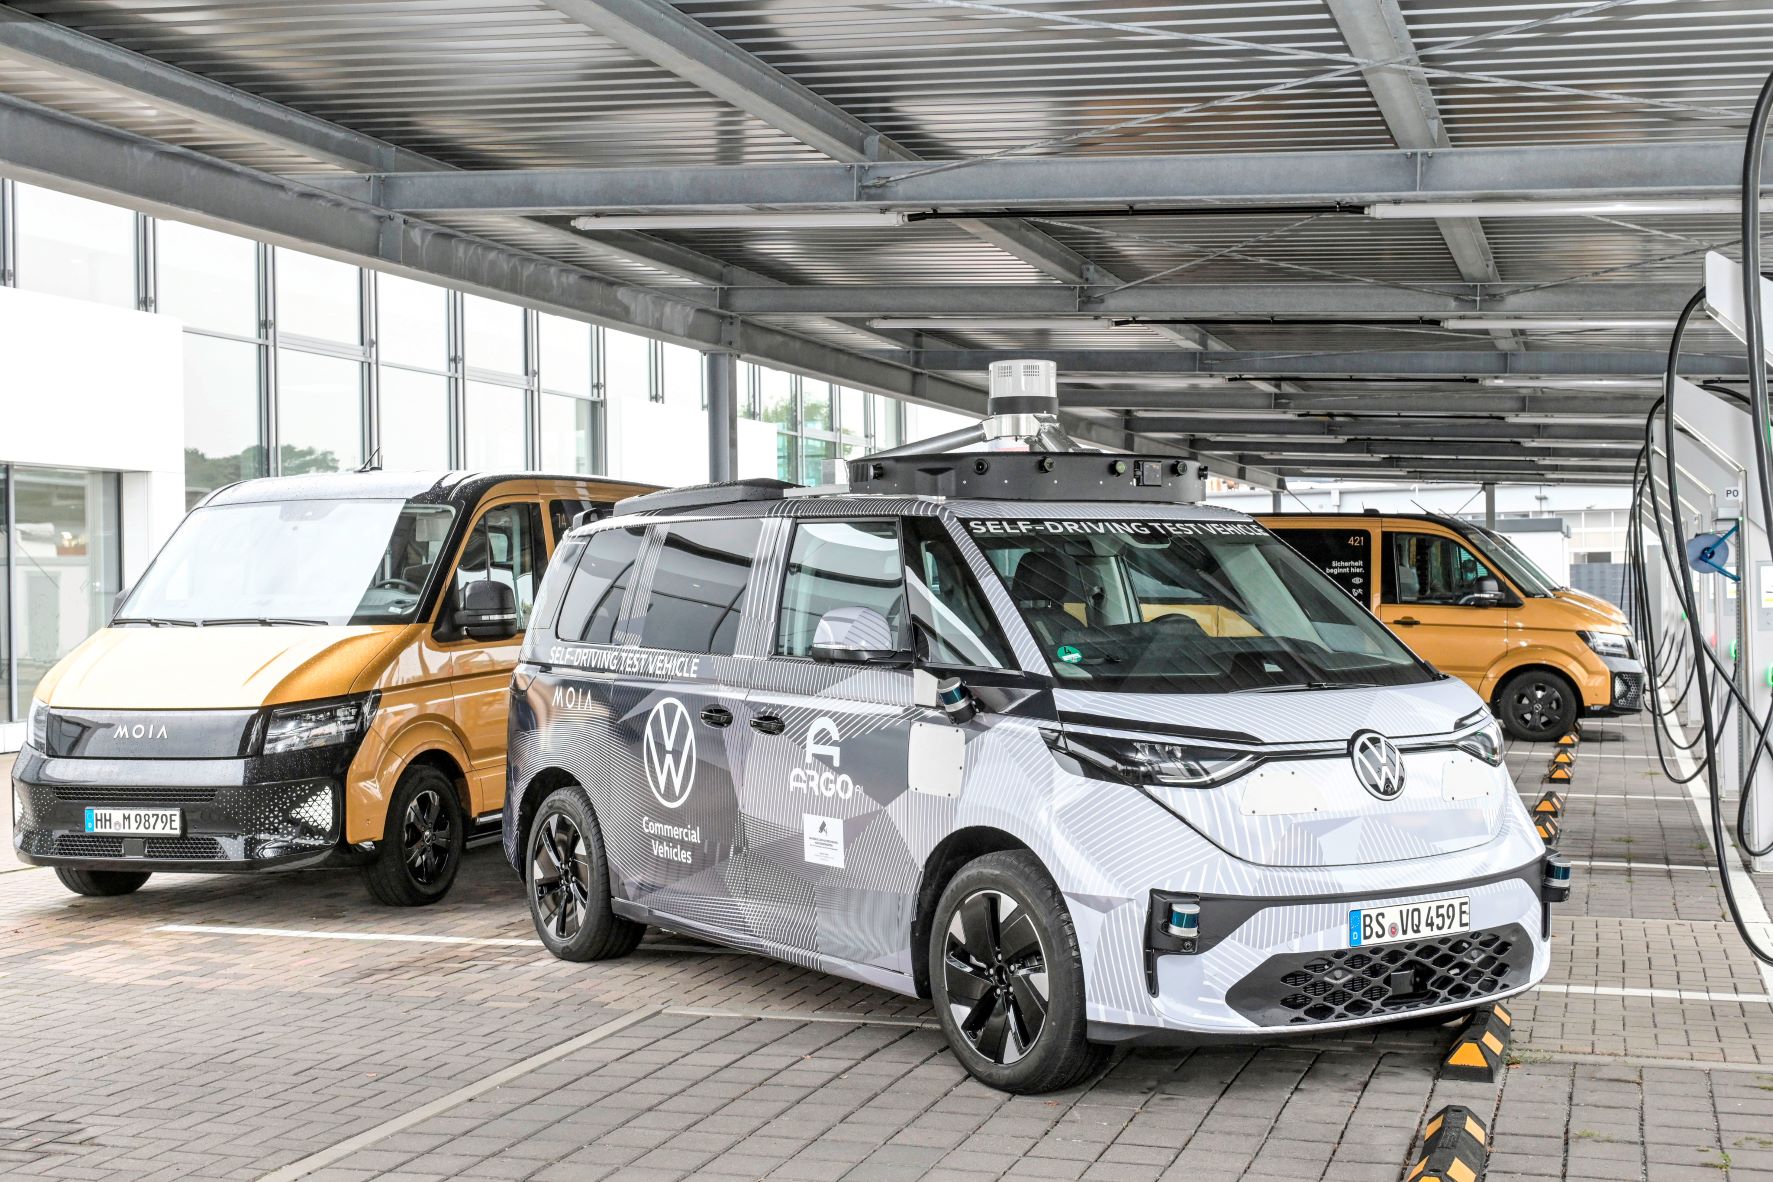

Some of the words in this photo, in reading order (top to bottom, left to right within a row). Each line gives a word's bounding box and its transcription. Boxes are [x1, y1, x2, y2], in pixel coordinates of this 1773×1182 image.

[969, 521, 1150, 535] SELF-DRIVING
[1149, 522, 1202, 535] TEST
[1199, 523, 1270, 536] VEHICLE
[1348, 536, 1364, 546] 421
[1325, 567, 1350, 575] beginnt
[549, 646, 619, 671] SELF-DRIVING
[620, 652, 648, 673] TEST
[649, 655, 700, 678] VEHICLE
[552, 686, 592, 711] MOIA
[113, 724, 168, 739] MOIA
[790, 767, 854, 800] ARGO
[95, 812, 112, 830] HH
[122, 813, 131, 830] M
[134, 813, 178, 831] 9879E
[643, 816, 700, 844] Commercial
[652, 839, 692, 864] Vehicles
[1362, 912, 1386, 940] BS
[1400, 908, 1421, 935] VQ
